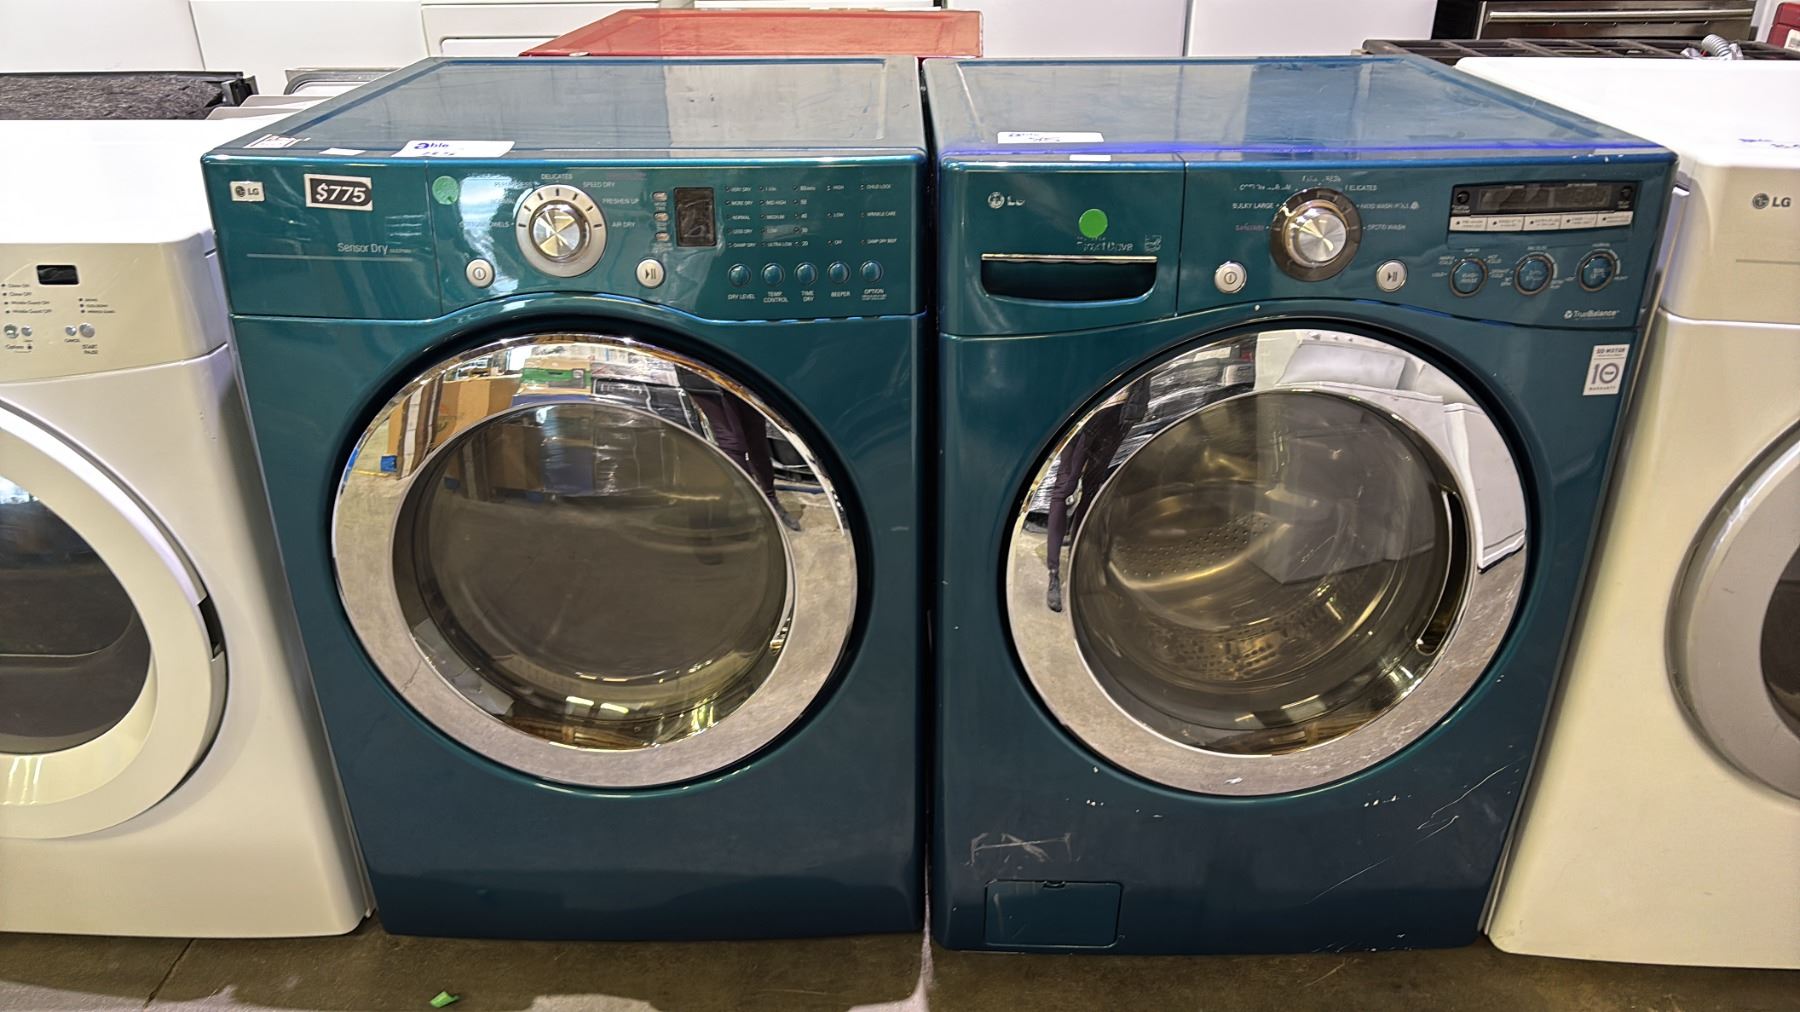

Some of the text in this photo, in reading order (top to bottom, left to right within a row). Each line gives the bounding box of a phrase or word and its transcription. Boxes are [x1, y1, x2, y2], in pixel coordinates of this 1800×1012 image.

[247, 187, 260, 196] LG
[315, 182, 366, 203] $775
[1772, 196, 1791, 208] LG
[337, 242, 368, 252] Sensor
[370, 243, 389, 255] Dry
[1591, 362, 1620, 385] 10
